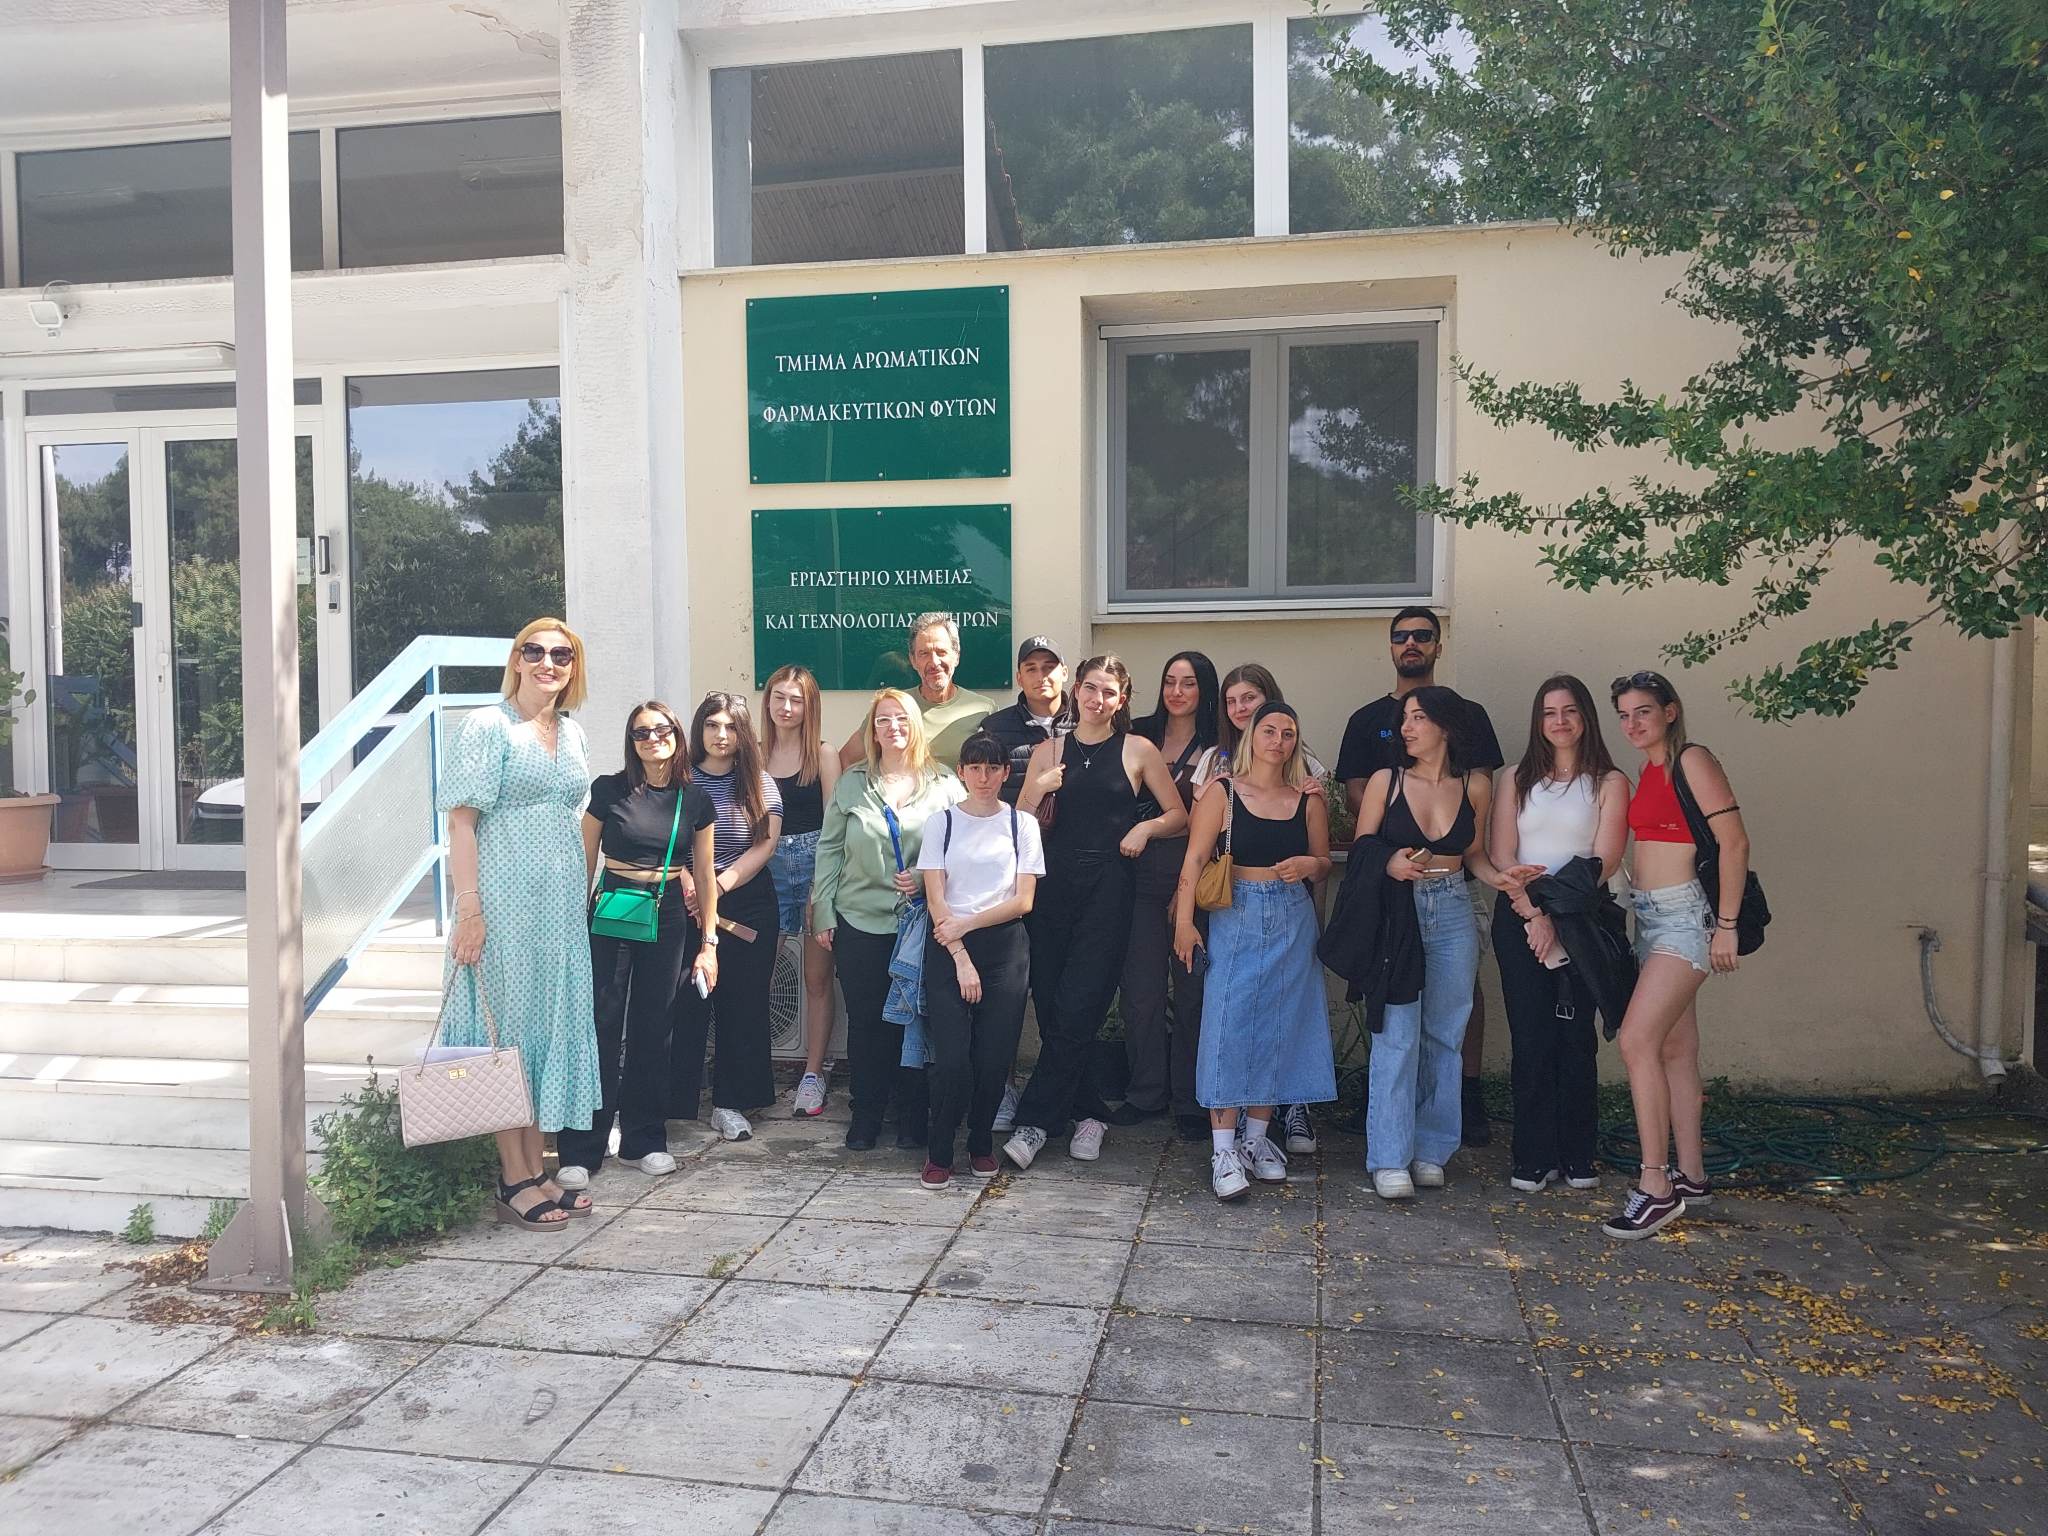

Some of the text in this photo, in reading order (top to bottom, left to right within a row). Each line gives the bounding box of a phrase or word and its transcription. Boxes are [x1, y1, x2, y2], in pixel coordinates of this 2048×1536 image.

[775, 347, 980, 373] ΤΜΗΜΑ ΑΡΩΜΑΤΙΚΩΝ
[763, 398, 996, 423] ΦΑΡΜΑΚΕΥΤΙΚΩΝ ΦΥΤΩΝ
[790, 568, 972, 587] ΕΡΓΑΣΤΗΡΙΟ ΧΗΜΕΙΑΣ
[765, 611, 998, 630] ΚΑΙ ΤΕΧΝΟΛΟΓΙΑΣ ΗΡΩΝ
